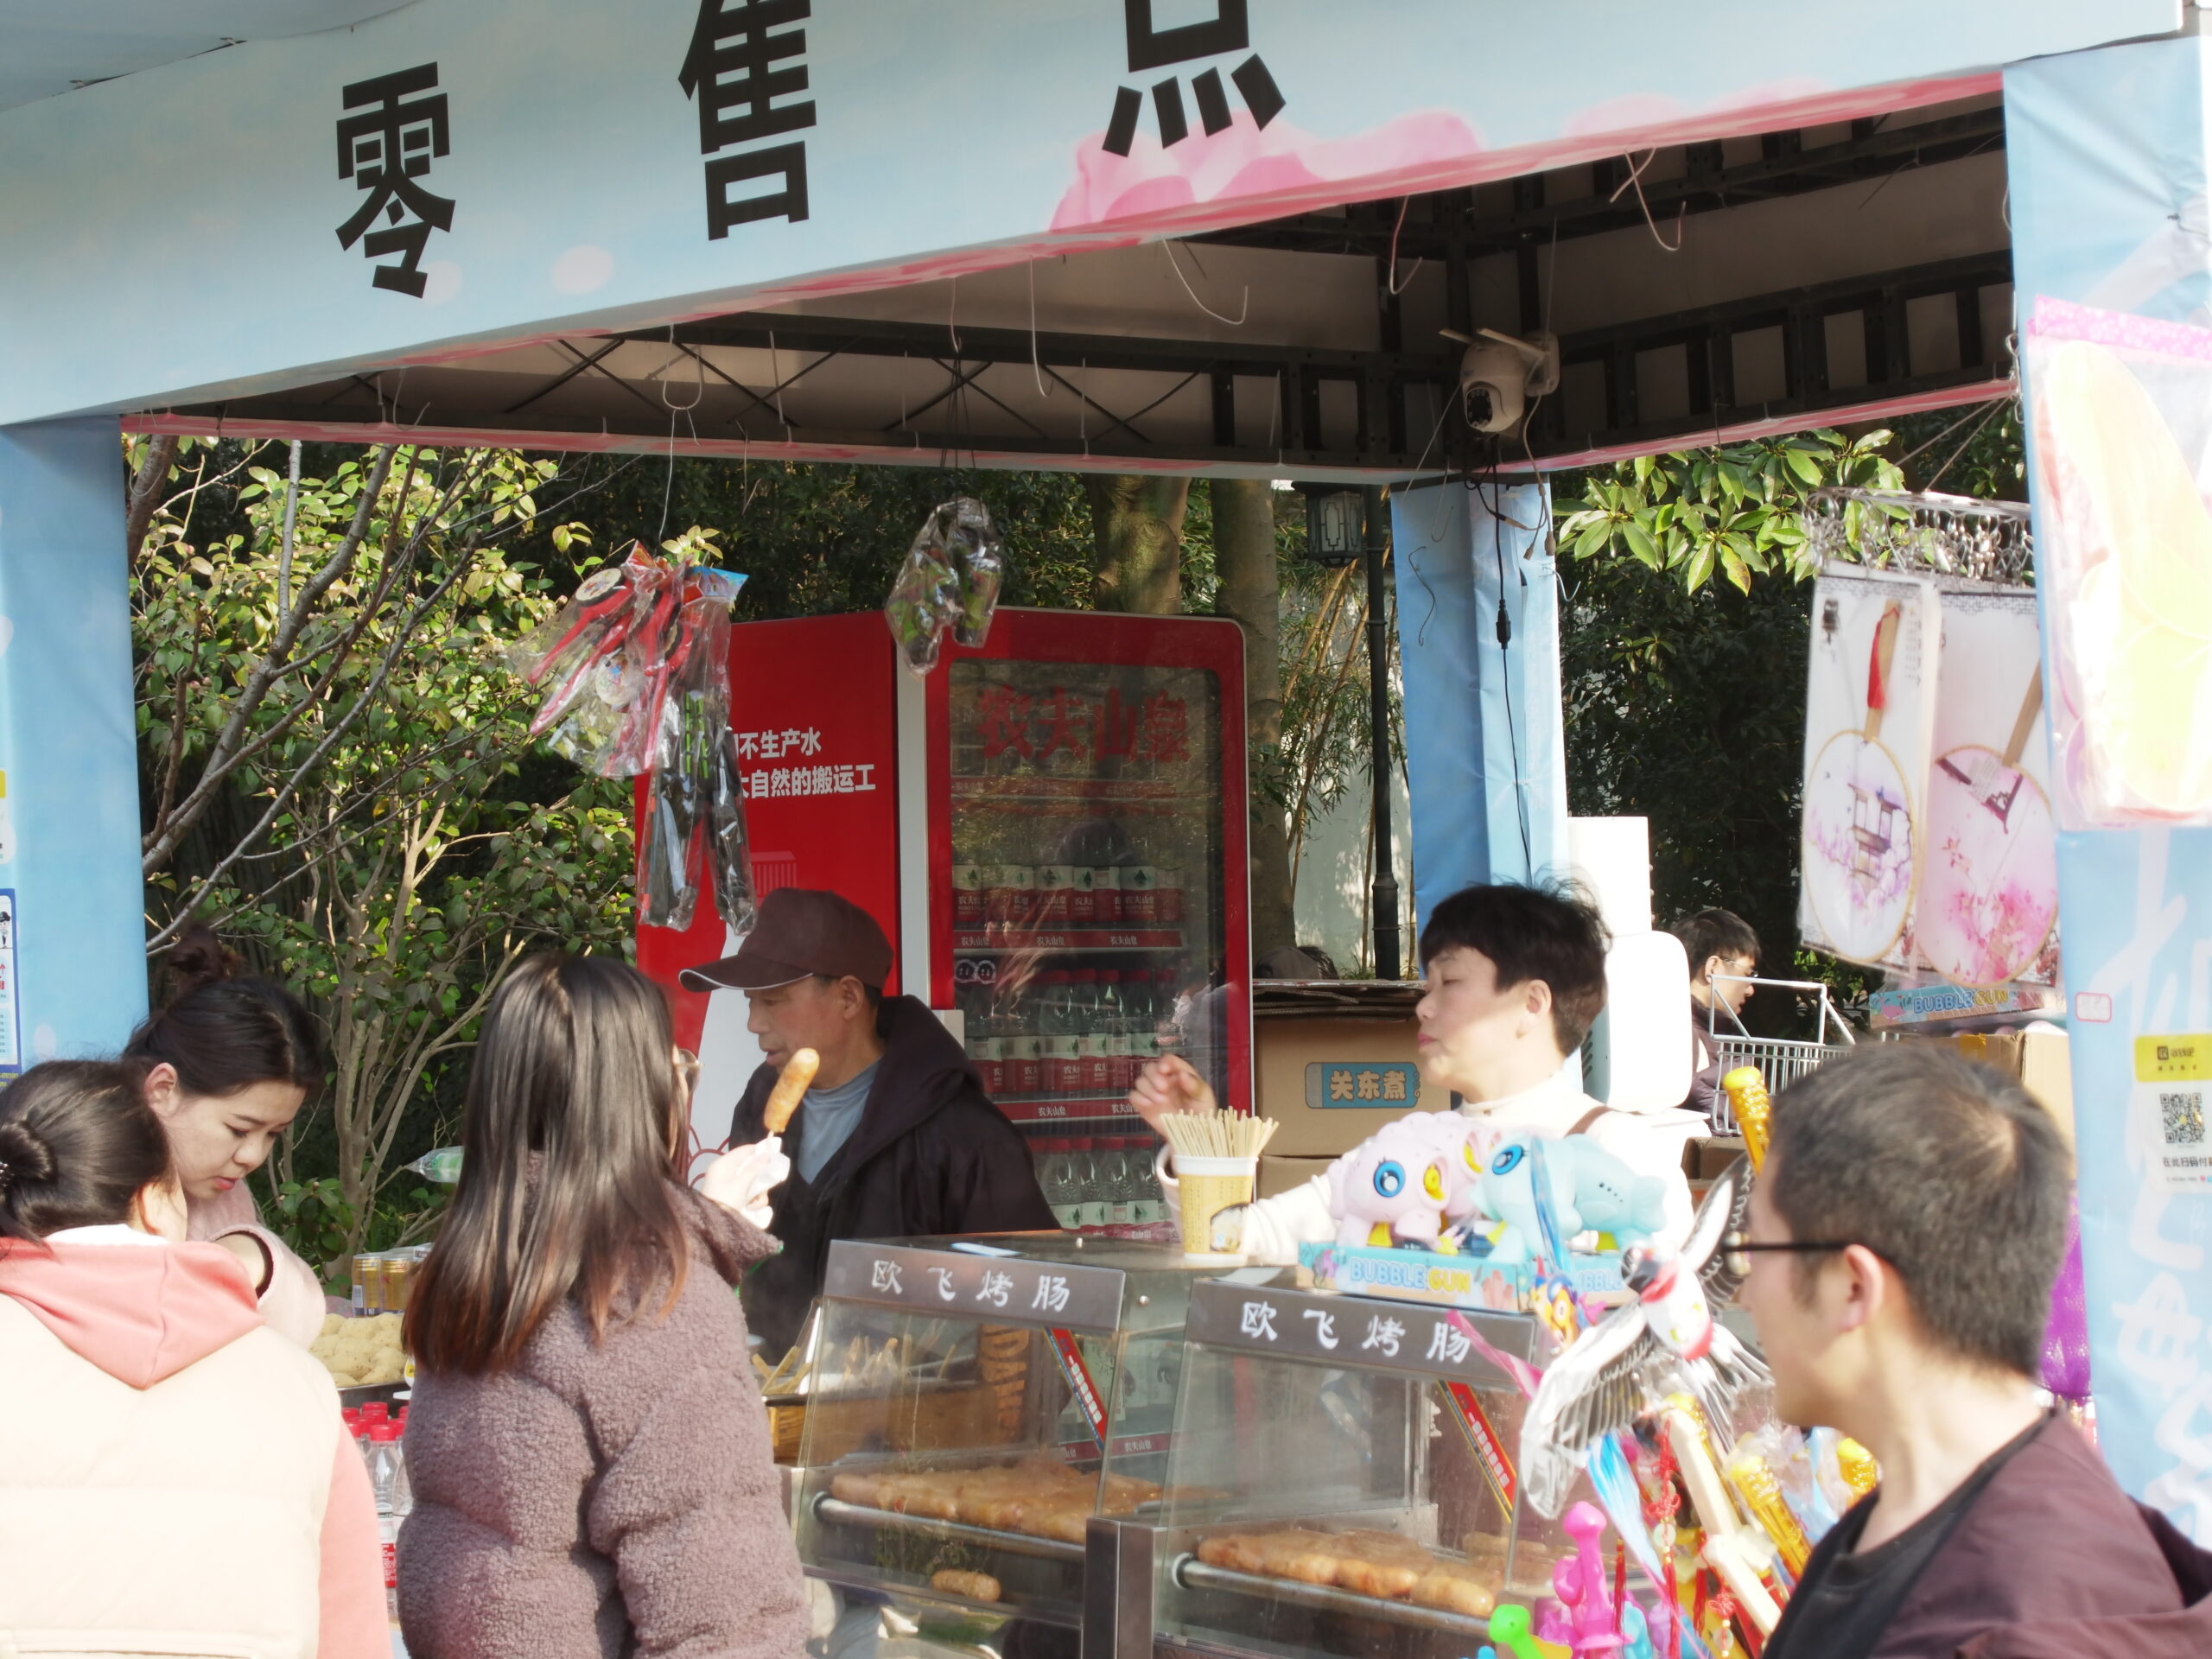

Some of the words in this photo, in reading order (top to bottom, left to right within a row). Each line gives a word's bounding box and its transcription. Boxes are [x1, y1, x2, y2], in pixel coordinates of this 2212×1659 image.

[977, 683, 1191, 764] 农夫山泉
[1913, 991, 1974, 1014] BUBBLE
[1974, 988, 2009, 1007] GUN
[1330, 1070, 1406, 1101] 关东煮
[871, 1259, 1071, 1313] 欧飞烤肠
[1350, 1256, 1427, 1290] BUBBLE
[1427, 1265, 1471, 1294] GUN
[1240, 1300, 1471, 1364] 欧飞烤肠
